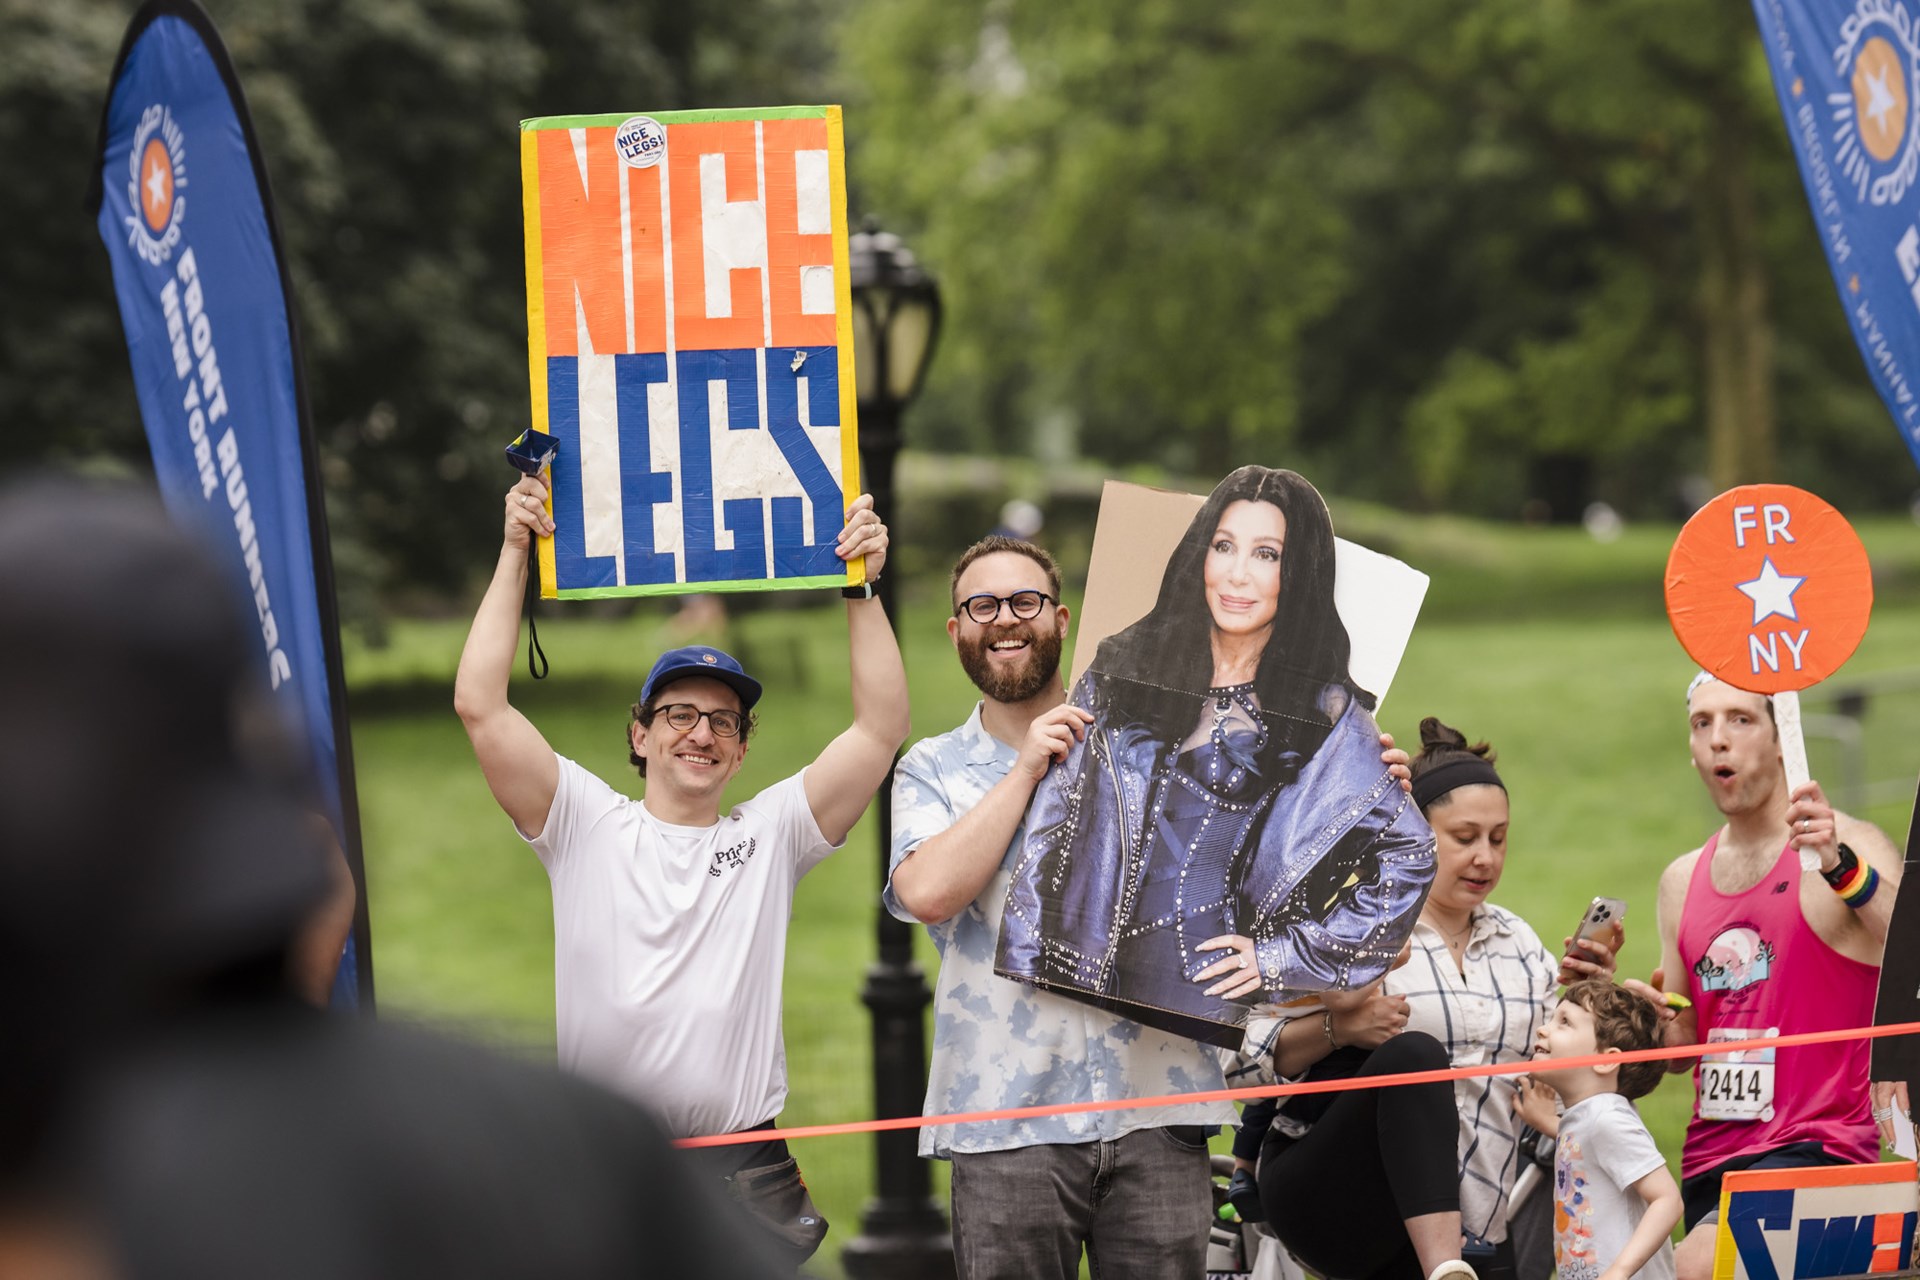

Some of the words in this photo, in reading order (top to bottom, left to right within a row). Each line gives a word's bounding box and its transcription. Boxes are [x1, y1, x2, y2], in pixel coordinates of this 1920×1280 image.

[617, 127, 650, 149] NICE
[624, 134, 664, 159] LEGS!
[537, 117, 836, 356] NICE
[160, 276, 193, 380] NEW
[183, 377, 219, 501] YORK
[177, 246, 228, 425] FRONT
[547, 345, 848, 589] LEGS
[1733, 503, 1796, 548] FR
[1748, 628, 1810, 674] NY
